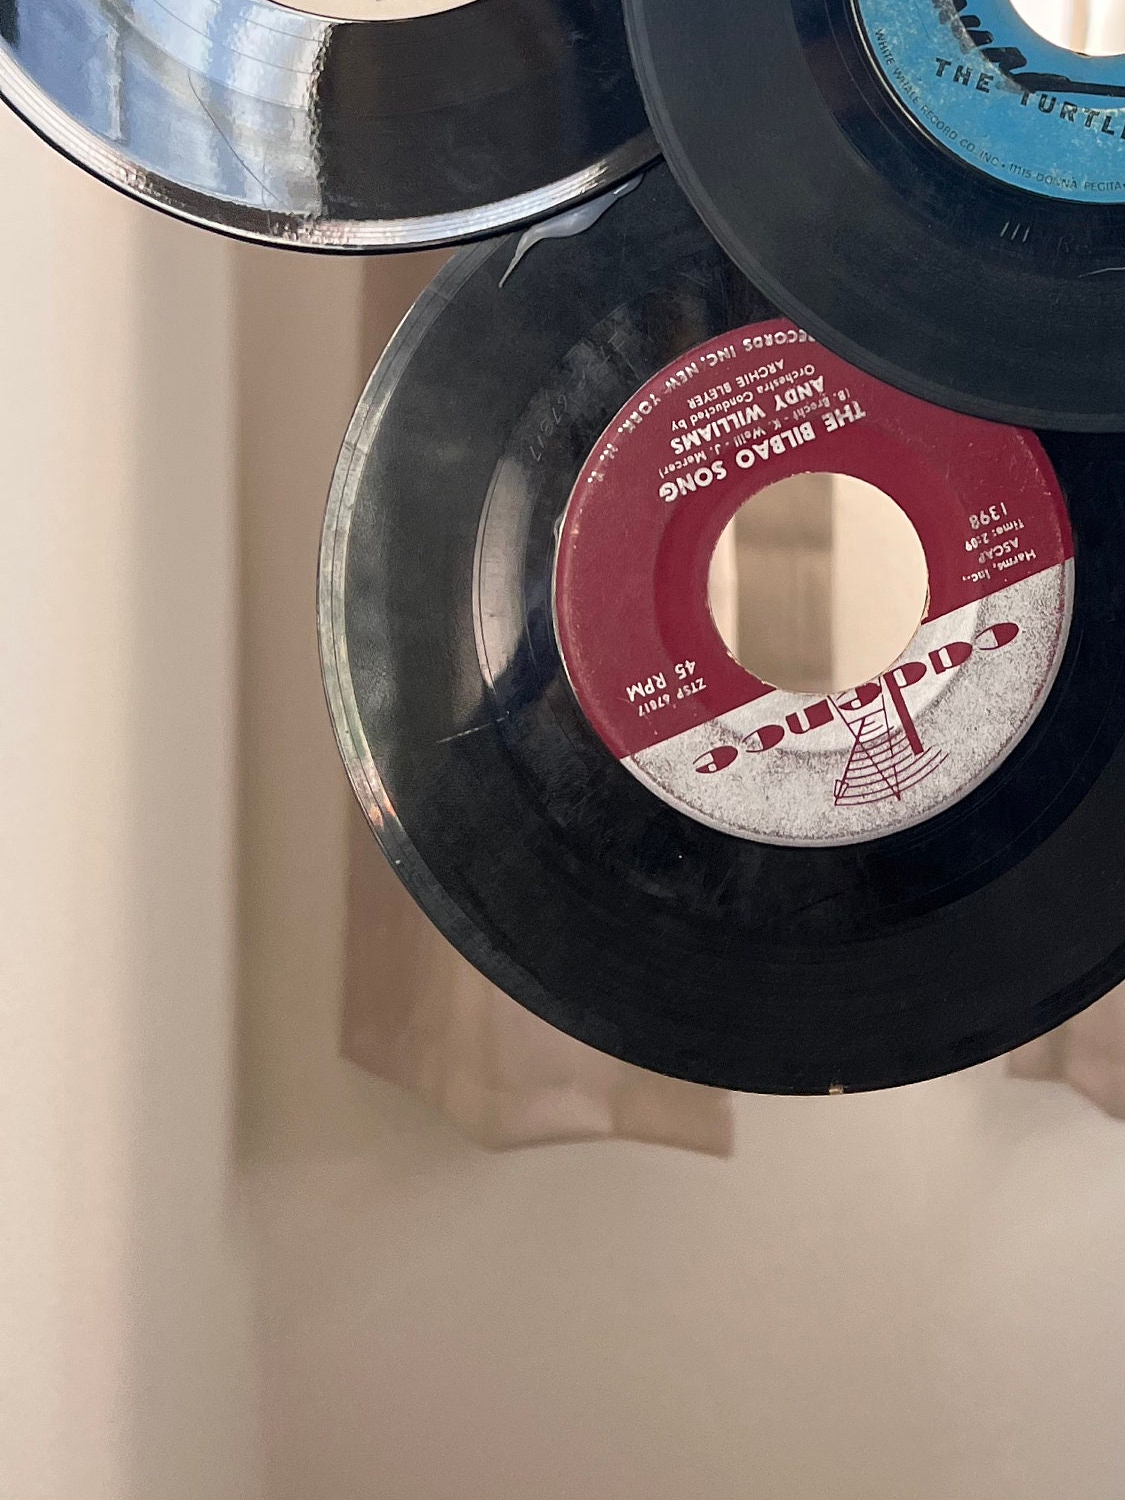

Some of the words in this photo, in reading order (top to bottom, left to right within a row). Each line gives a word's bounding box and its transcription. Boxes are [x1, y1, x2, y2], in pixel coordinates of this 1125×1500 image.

[875, 29, 895, 66] WHITE
[893, 67, 921, 104] WHALE
[920, 105, 958, 141] RECORD
[935, 57, 994, 94] THE
[664, 362, 699, 394] NEW
[736, 358, 784, 387] ARCHIE
[756, 364, 816, 394] Orchestra
[687, 382, 733, 410] BLEYER
[774, 375, 825, 412] ANDY
[690, 391, 754, 426] Conducted
[793, 397, 831, 421] Brecht
[821, 401, 867, 433] THE
[670, 403, 766, 455] WILLIAMS
[671, 420, 688, 432] by
[733, 426, 767, 448] Weill
[735, 421, 816, 469] BILBAO
[658, 450, 708, 479] Mercer)
[659, 460, 728, 503] SONG
[969, 501, 1008, 530] 1398
[991, 518, 1025, 537] Time:
[965, 532, 989, 552] 2:09
[978, 536, 1019, 564] ASCAP
[992, 549, 1037, 571] Harms,
[674, 659, 696, 680] 45
[626, 671, 667, 702] RPM
[677, 677, 707, 700] ZTSP
[692, 621, 1020, 776] cadence
[638, 693, 670, 717] 67017
